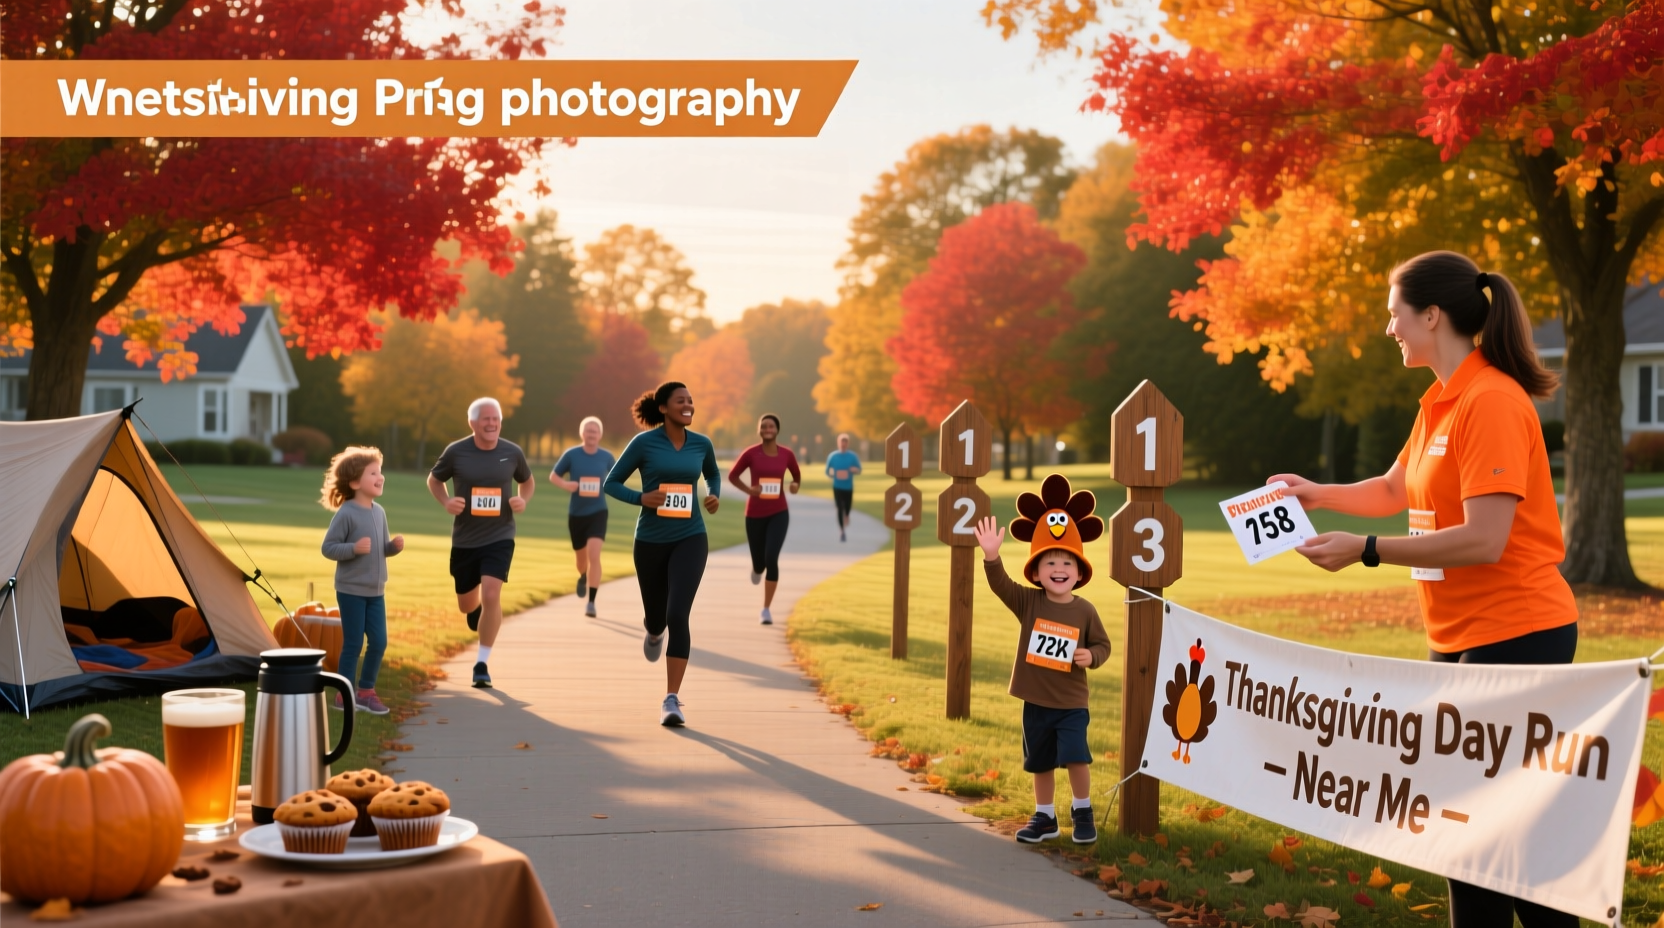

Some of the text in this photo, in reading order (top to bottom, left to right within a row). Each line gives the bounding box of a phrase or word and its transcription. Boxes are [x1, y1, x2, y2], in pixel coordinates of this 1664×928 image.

[898, 441, 909, 469] 1
[958, 429, 974, 466] 1
[1136, 418, 1157, 471] 1
[894, 493, 913, 521] 2
[953, 497, 977, 535] 2
[1246, 506, 1295, 545] 758
[1131, 518, 1165, 572] 3
[1036, 634, 1069, 659] 72K
[1226, 660, 1610, 781] Thanksgiving Day Run
[1293, 750, 1370, 817] Near
[1375, 773, 1430, 834] Me
